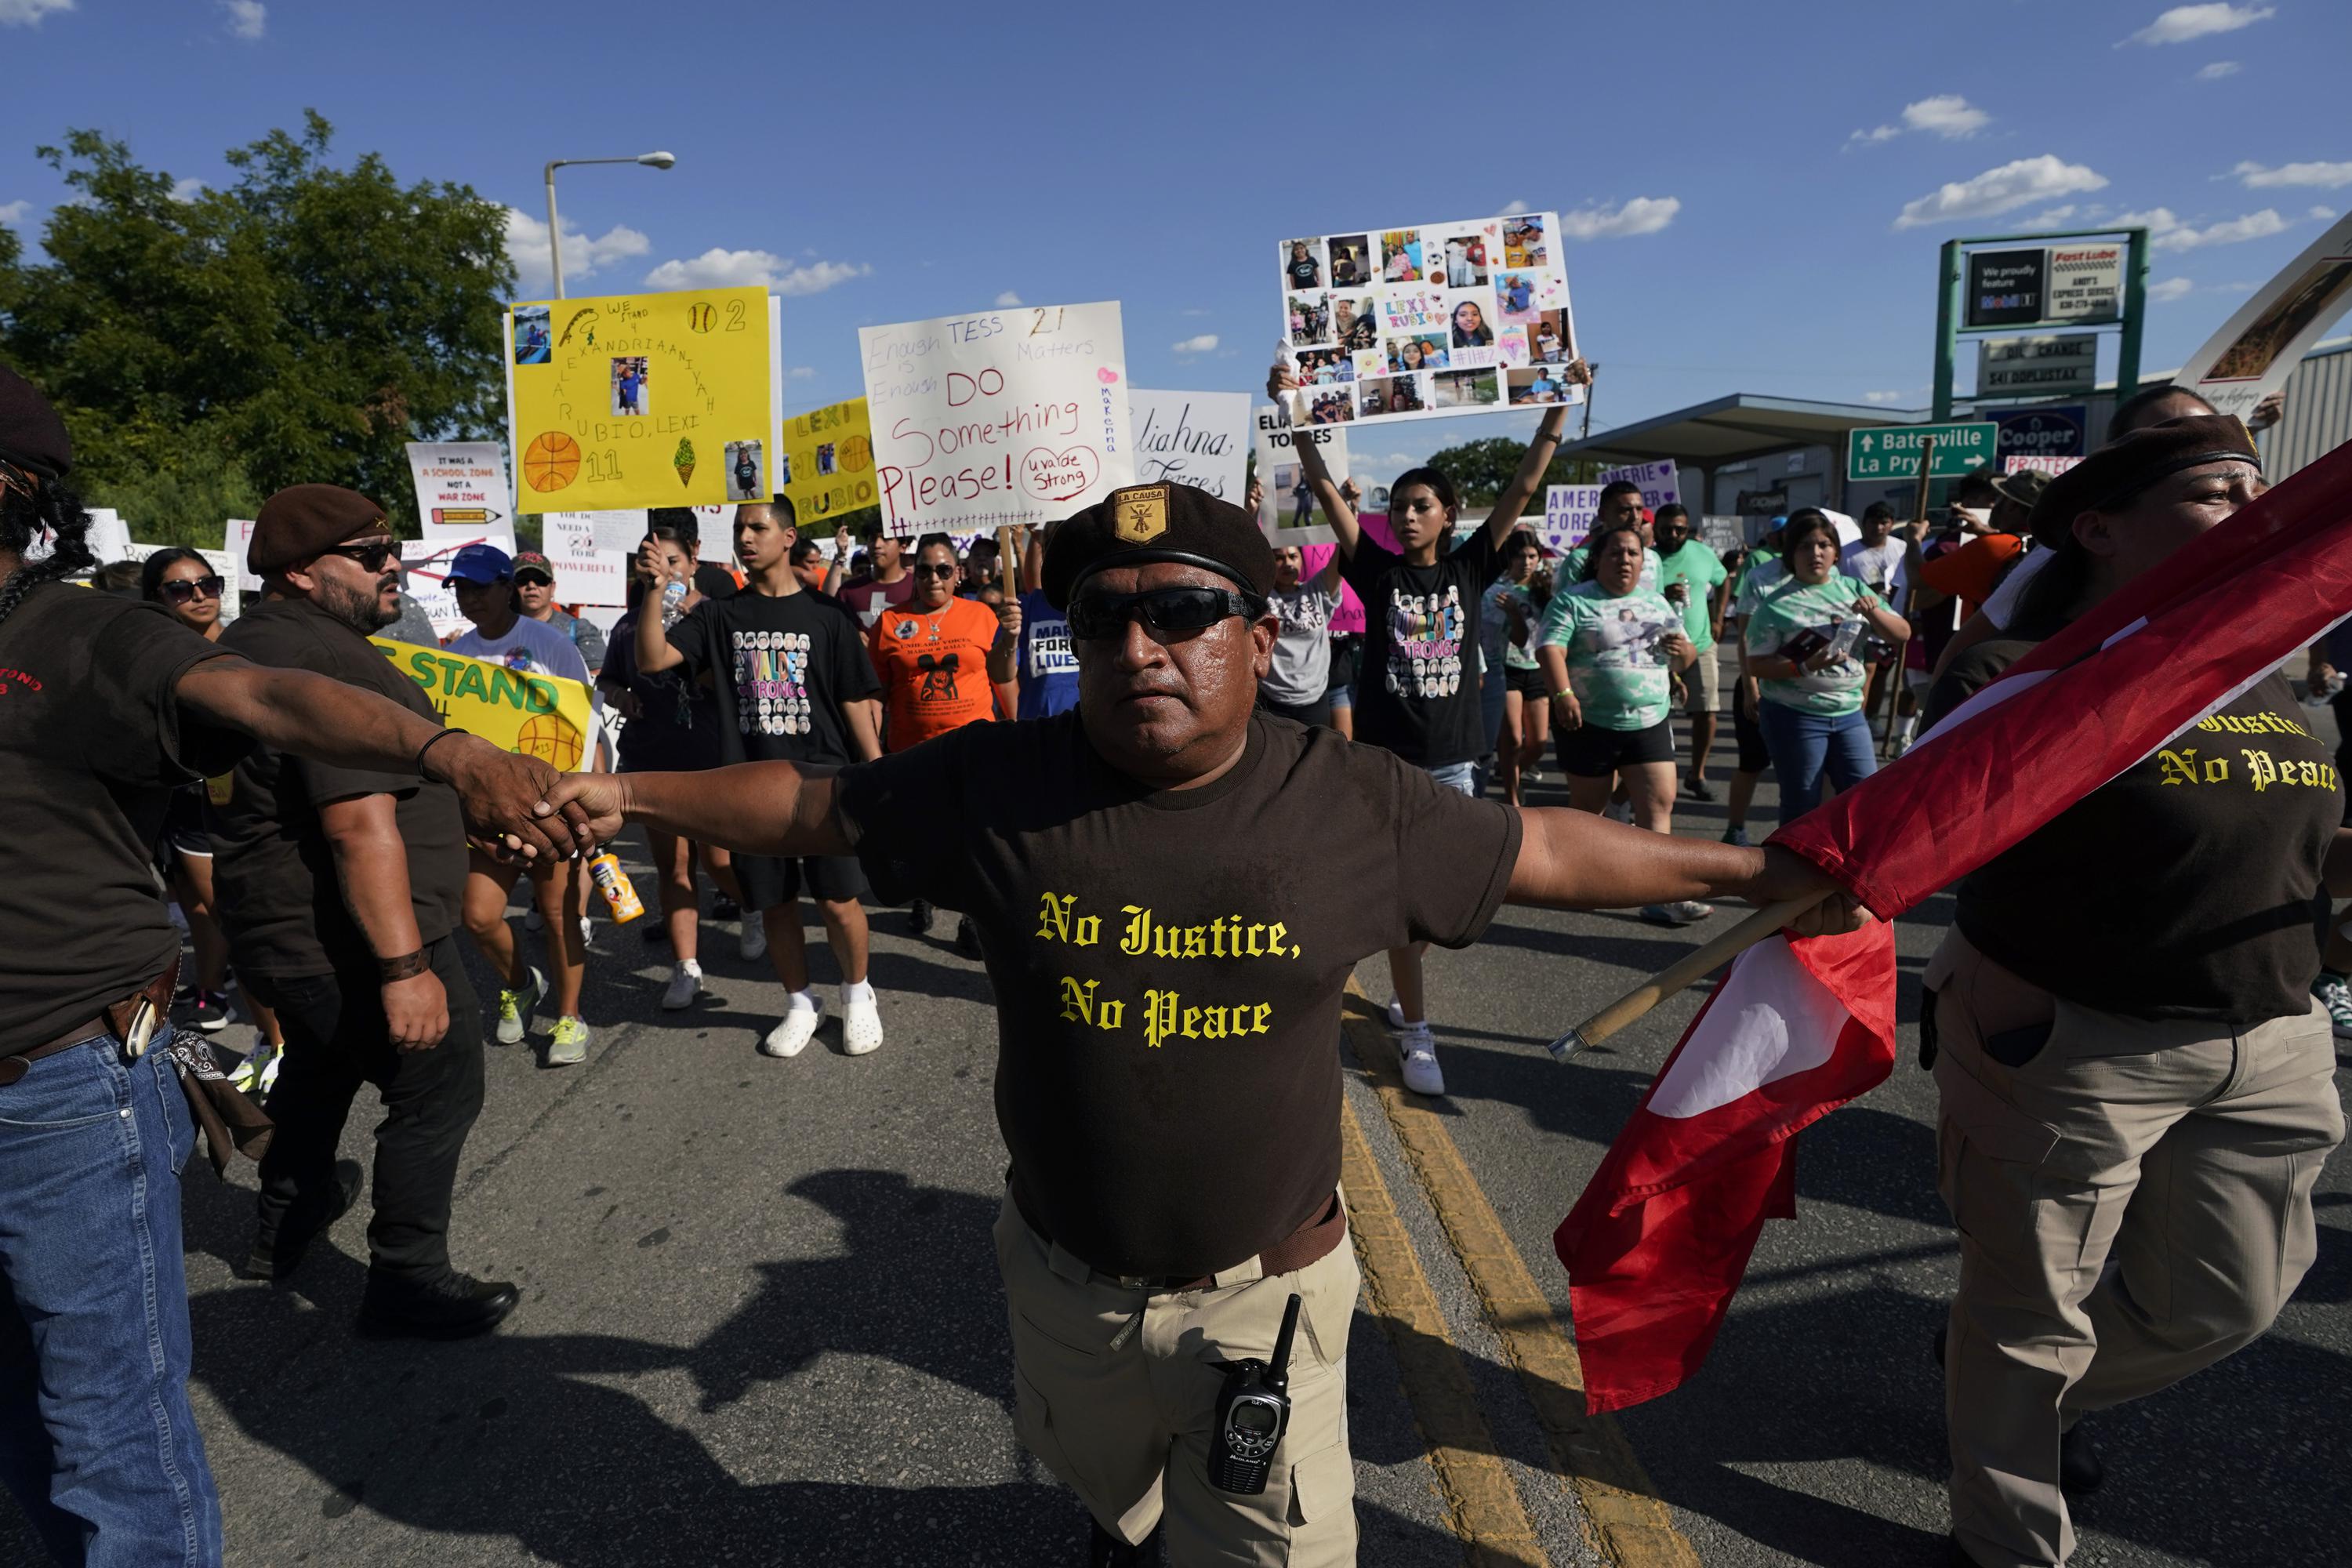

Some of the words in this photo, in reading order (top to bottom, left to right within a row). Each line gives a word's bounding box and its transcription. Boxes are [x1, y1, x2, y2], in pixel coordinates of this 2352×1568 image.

[2054, 252, 2083, 263] Fast
[2085, 251, 2118, 260] Lube
[1982, 267, 1999, 278] We
[2000, 264, 2037, 278] proudly
[1981, 278, 2015, 288] feature
[607, 301, 631, 315] WE
[1386, 298, 1429, 315] LEXI
[1980, 294, 2020, 310] Mobil
[621, 309, 648, 323] STAND
[725, 299, 746, 332] 2
[1029, 307, 1064, 338] 21
[1389, 312, 1434, 328] RUBIO
[946, 317, 1004, 344] TESS
[868, 332, 941, 372] Enough
[1018, 339, 1094, 362] Matters
[872, 376, 938, 406] Enough
[946, 368, 1004, 407] DO
[796, 403, 851, 437] LEXI
[892, 402, 1079, 469] Something
[1130, 403, 1233, 457] liahna
[1268, 429, 1332, 449] TOES
[1999, 429, 2074, 448] Cooper
[1882, 429, 1982, 451] Batesville
[432, 468, 465, 477] SCHOOL
[470, 468, 494, 477] ZONE
[586, 448, 623, 483] 11
[1857, 457, 1880, 474] La
[877, 453, 1013, 518] Please!
[1133, 490, 1163, 499] CAUSA
[438, 493, 459, 502] WAR
[462, 493, 486, 502] ZONE
[797, 480, 872, 521] RUBIO
[557, 523, 582, 532] NEED
[583, 550, 598, 558] BE
[551, 561, 617, 574] POWERFUL
[1036, 639, 1069, 652] FOR
[1398, 640, 1454, 659] TRONG
[1036, 653, 1080, 670] LIVE
[410, 652, 559, 714] STAND
[748, 681, 797, 699] TRONG
[2158, 749, 2229, 786] No
[1035, 891, 1103, 947] No
[1120, 905, 1301, 960] Justice,
[1059, 976, 1126, 1030] No
[1144, 989, 1272, 1048] Peace
[1229, 1454, 1258, 1464] MIDLAND
